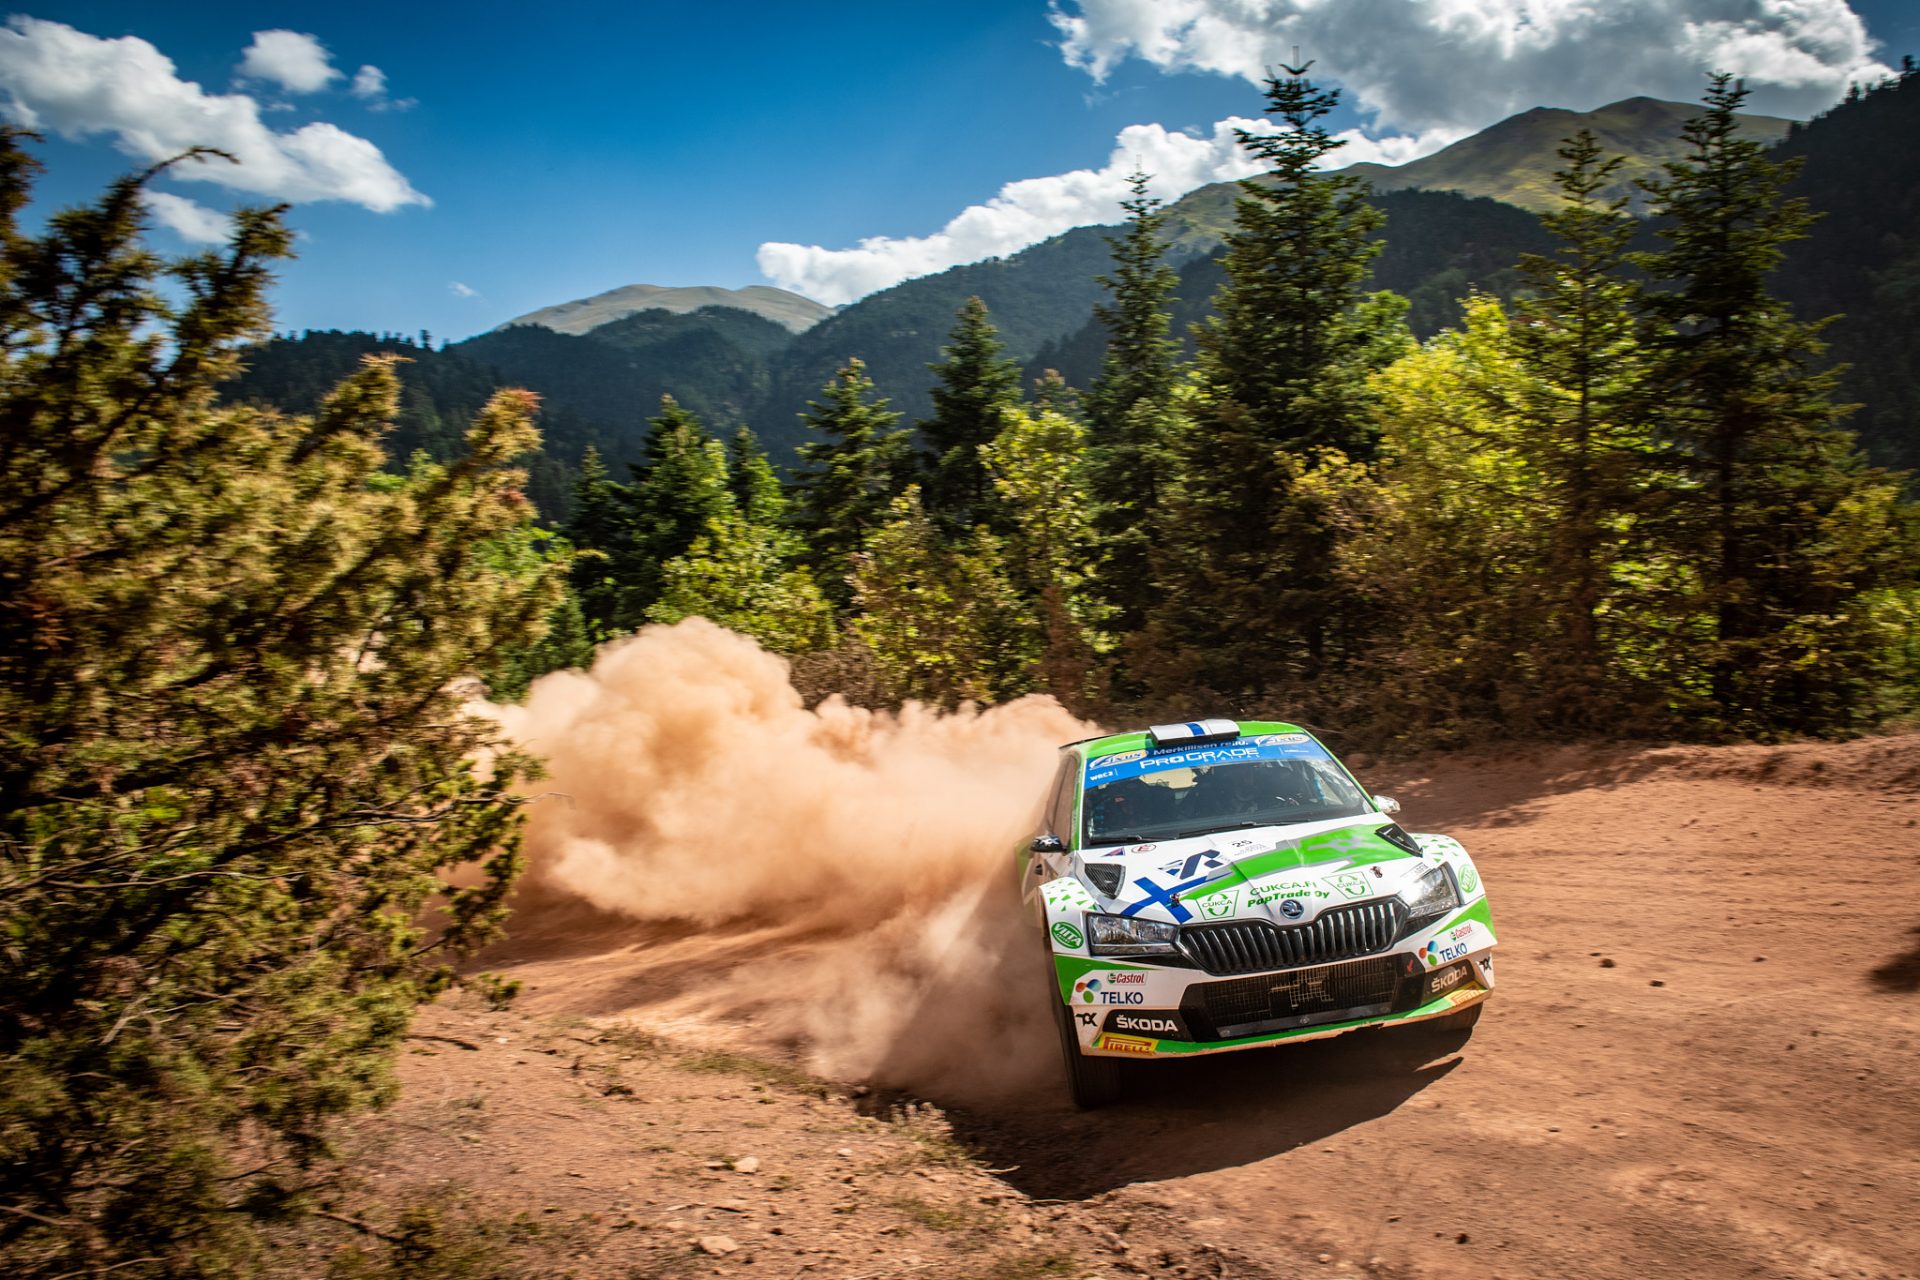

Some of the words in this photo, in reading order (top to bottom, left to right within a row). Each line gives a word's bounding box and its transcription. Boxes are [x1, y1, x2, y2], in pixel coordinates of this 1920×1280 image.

[1231, 839, 1253, 848] 25
[1202, 899, 1233, 908] CUKCA
[1247, 890, 1311, 908] PapTrade
[1440, 942, 1468, 962] TELKO
[1115, 972, 1145, 984] Castrol
[1431, 966, 1468, 993] ŠKODA
[1100, 992, 1144, 1005] TELKO
[1116, 1014, 1178, 1032] ŠKODA
